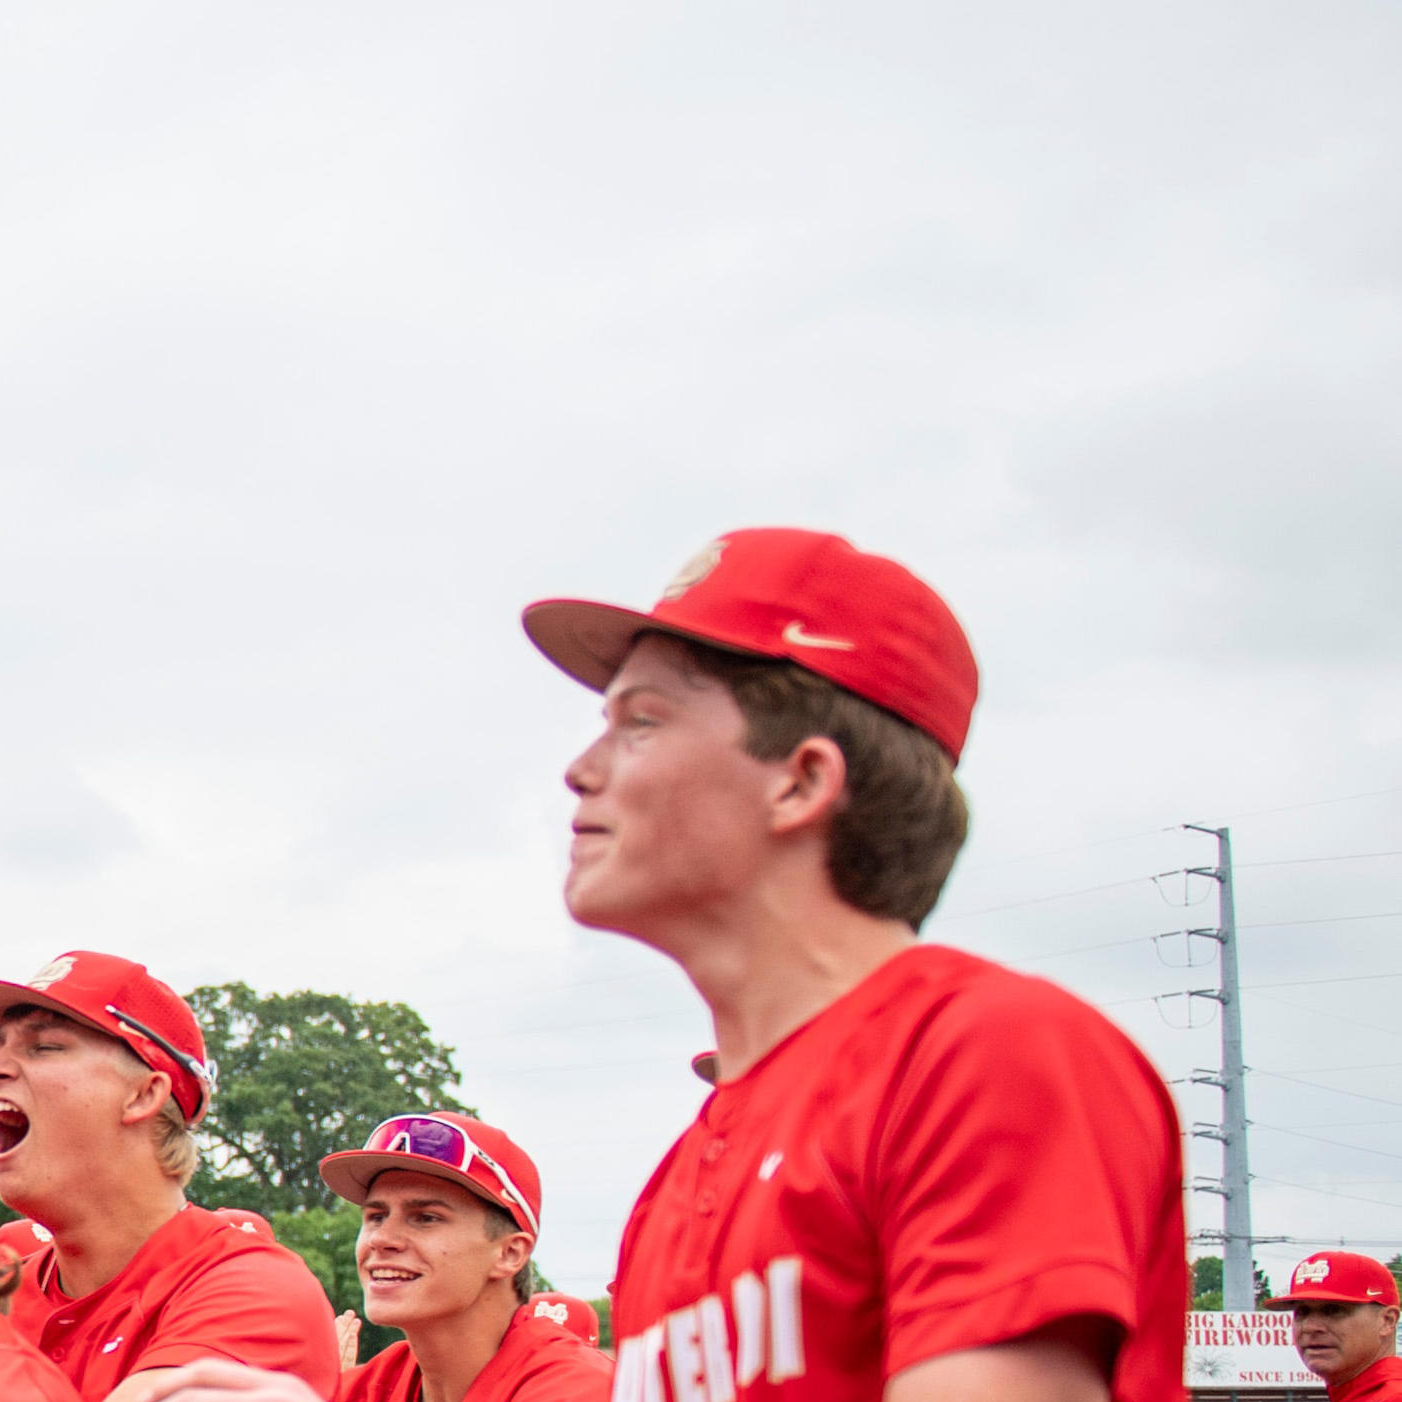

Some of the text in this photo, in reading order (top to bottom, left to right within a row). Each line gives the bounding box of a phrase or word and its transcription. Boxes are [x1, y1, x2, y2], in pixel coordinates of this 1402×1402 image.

[1185, 1313, 1292, 1328] BIG KABOO
[1185, 1329, 1296, 1346] FIREWOR
[1239, 1371, 1284, 1383] SINCE
